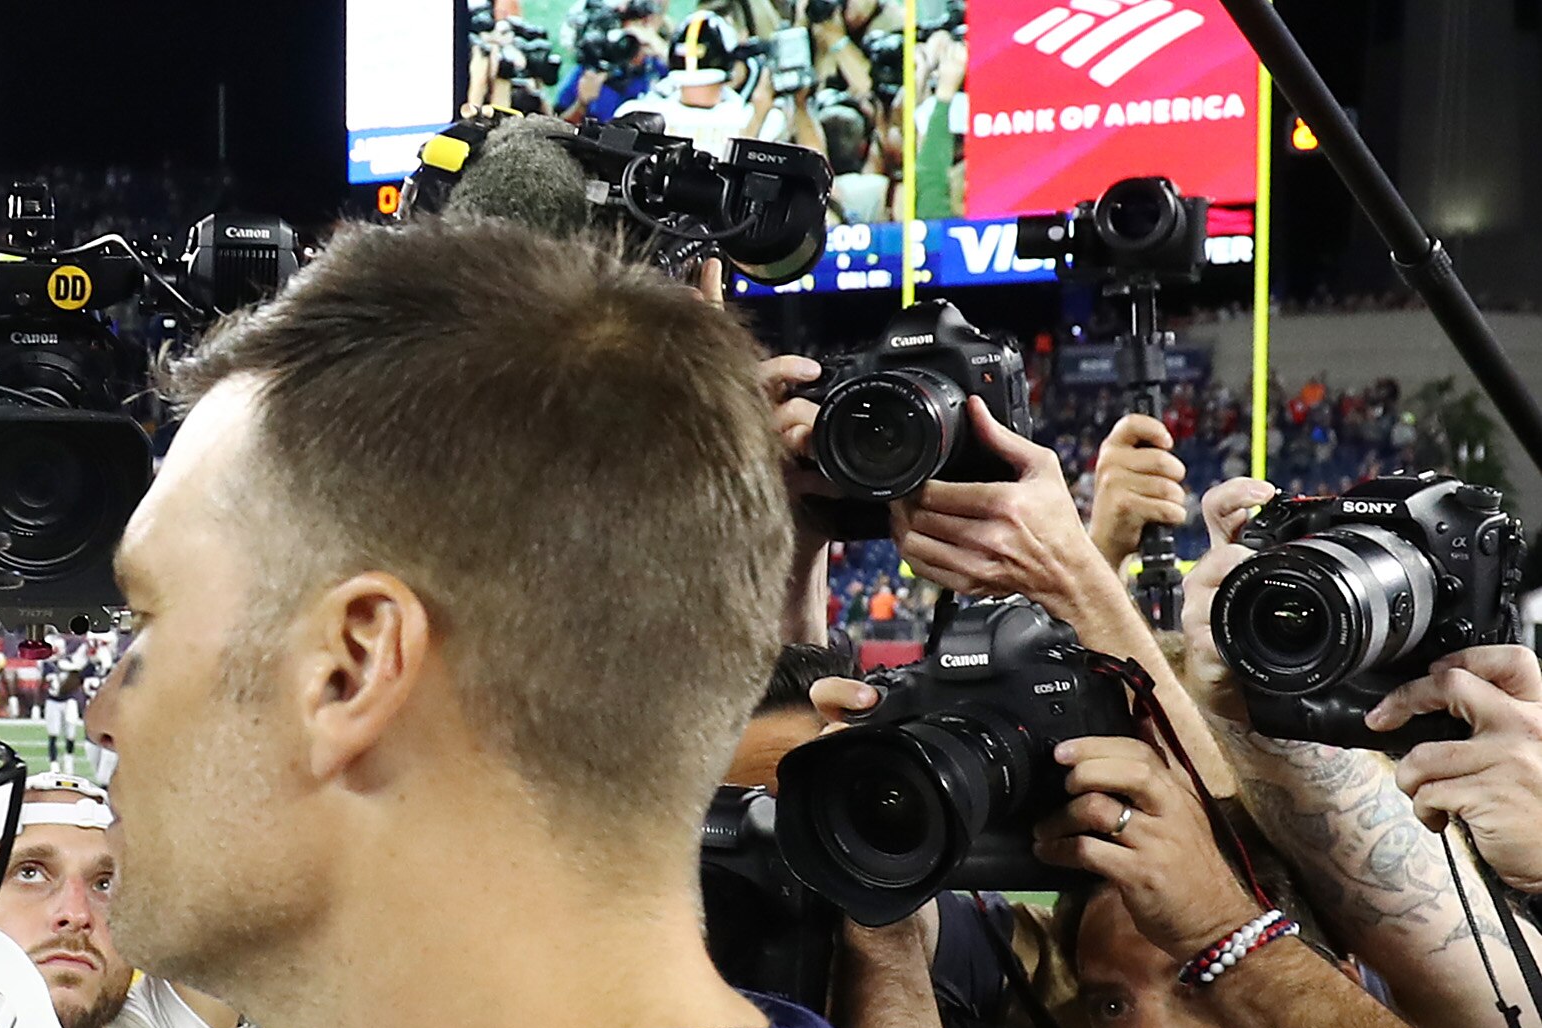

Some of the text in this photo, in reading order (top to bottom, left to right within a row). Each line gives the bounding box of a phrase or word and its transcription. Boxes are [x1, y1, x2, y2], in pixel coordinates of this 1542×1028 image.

[973, 93, 1245, 137] BANK OF AMERICA
[747, 151, 788, 165] SONY
[225, 226, 270, 239] Canon
[55, 275, 85, 299] DD
[11, 332, 58, 344] Canon
[891, 334, 934, 348] Canon
[1343, 501, 1397, 514] SONY
[940, 653, 989, 667] Canon
[1034, 681, 1070, 694] EOS-1D
